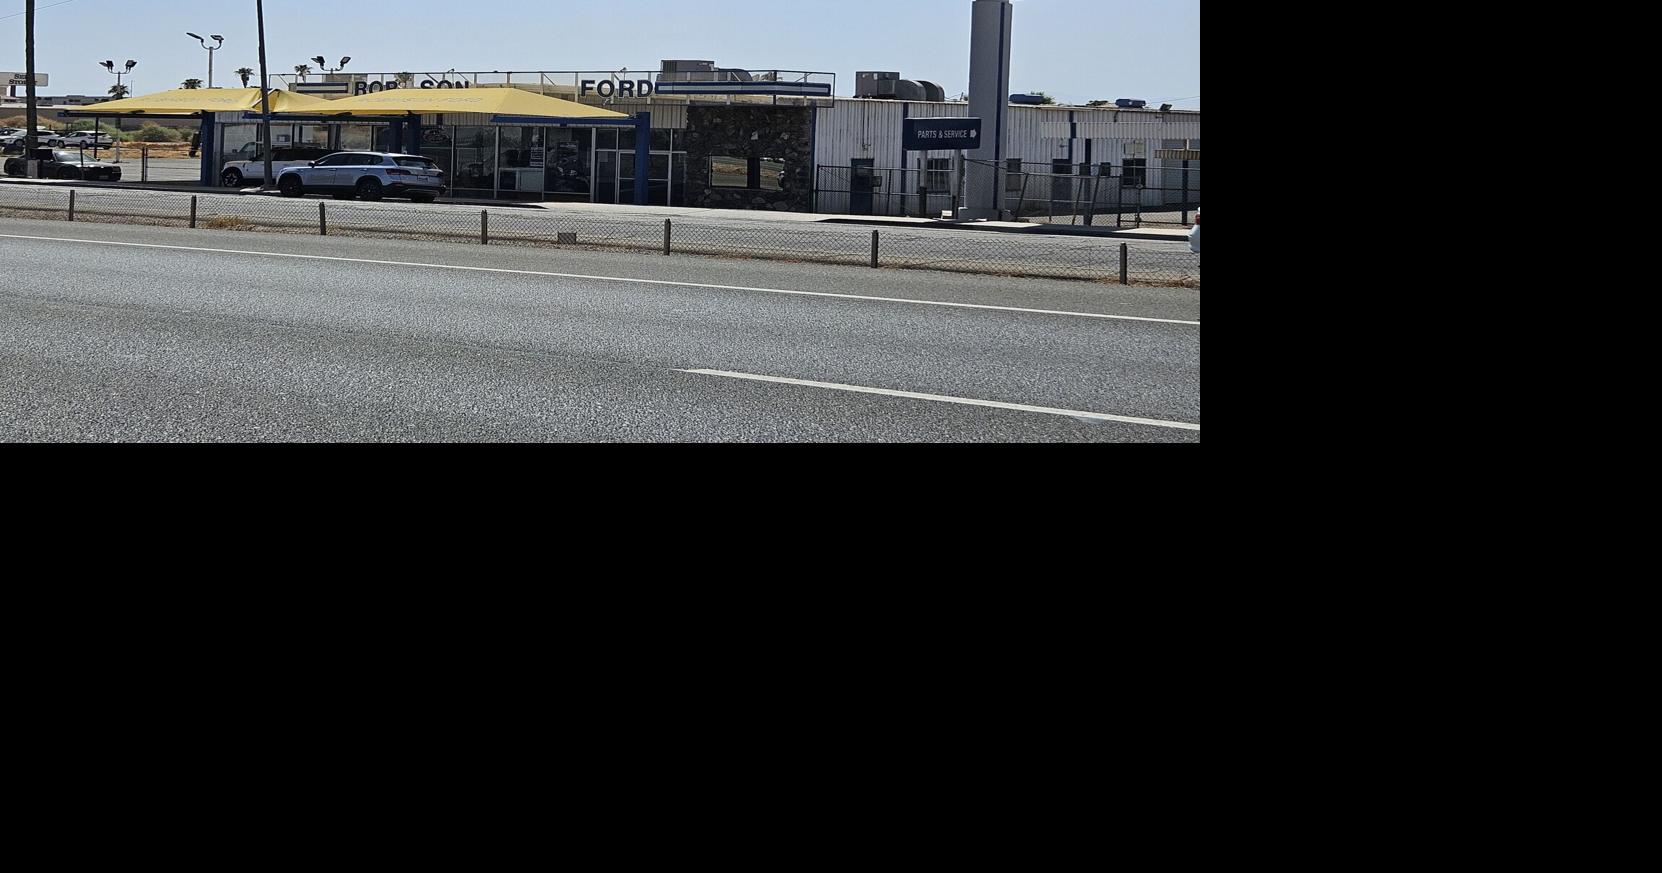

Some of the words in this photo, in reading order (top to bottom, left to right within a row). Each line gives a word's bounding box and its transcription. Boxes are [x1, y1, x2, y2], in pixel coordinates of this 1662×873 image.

[580, 79, 653, 98] FORD
[917, 130, 937, 139] PARTS
[938, 130, 943, 139] &
[943, 129, 967, 138] SERVICE
